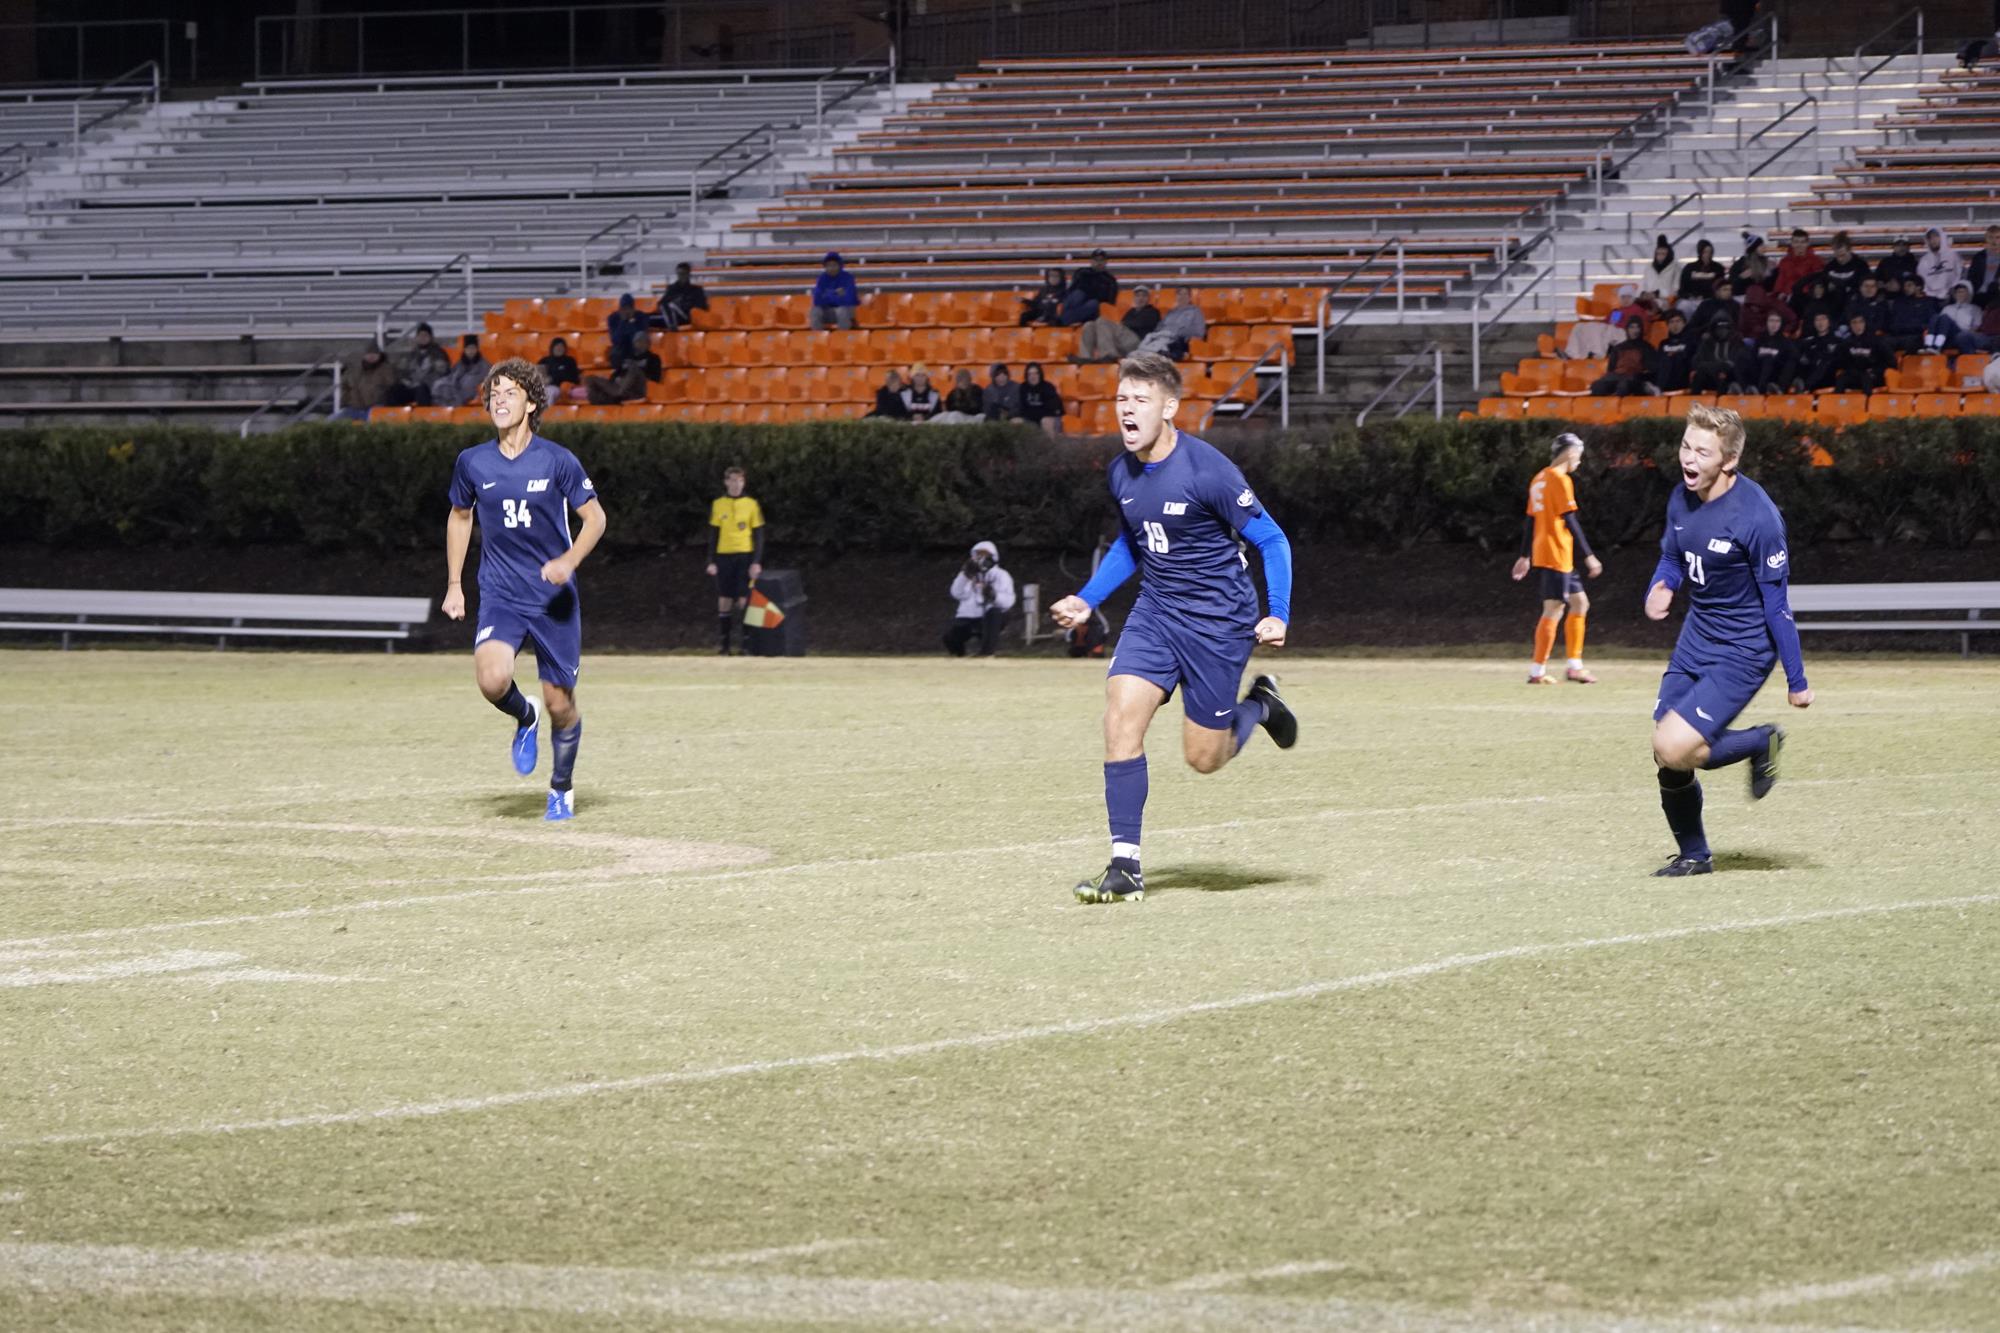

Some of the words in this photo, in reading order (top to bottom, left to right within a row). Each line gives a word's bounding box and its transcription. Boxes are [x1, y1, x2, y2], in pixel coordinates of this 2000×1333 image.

[503, 499, 532, 528] 34
[1143, 521, 1168, 553] 19
[1685, 551, 1705, 585] 21
